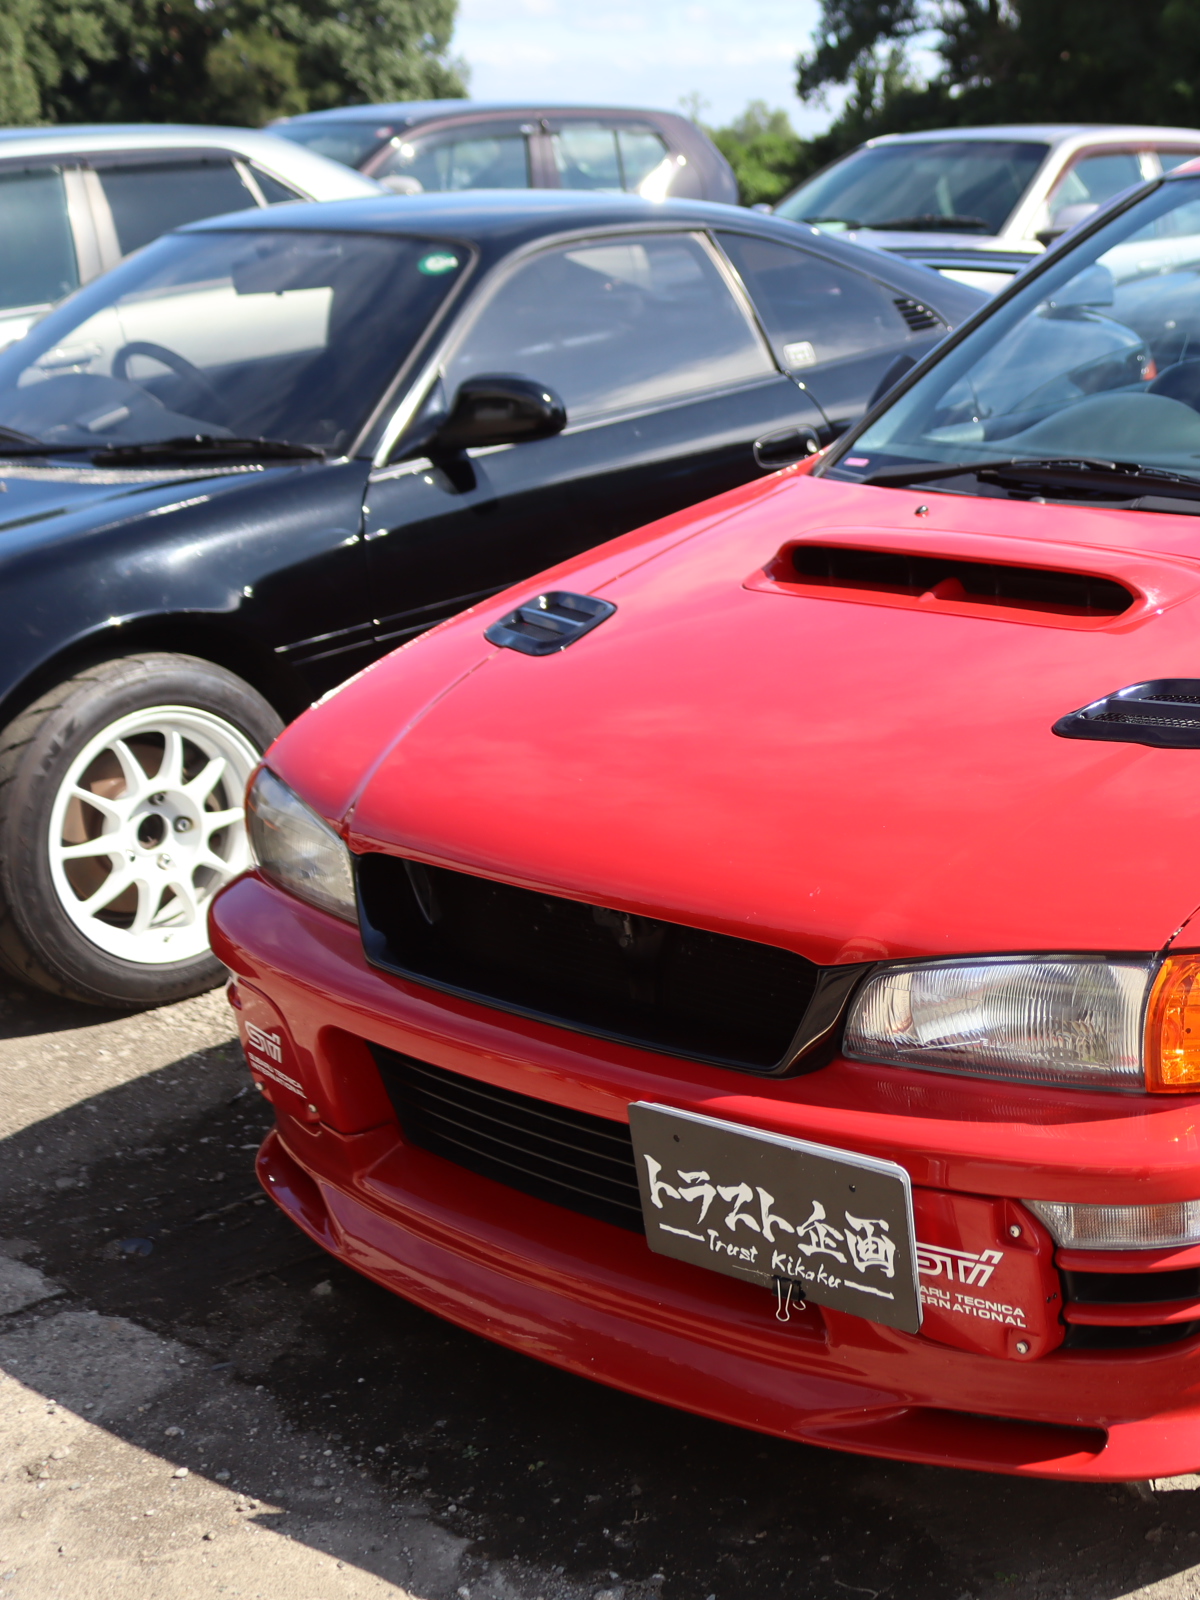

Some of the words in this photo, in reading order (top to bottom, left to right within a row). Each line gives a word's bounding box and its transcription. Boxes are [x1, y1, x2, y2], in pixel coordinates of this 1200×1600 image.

[643, 1153, 896, 1278] トラスト企画
[706, 1228, 759, 1264] Trust
[771, 1249, 842, 1289] Kikaku
[920, 1285, 950, 1300] ARU
[954, 1293, 1025, 1318] TECNICA
[920, 1295, 1027, 1328] ERNATIONAL
